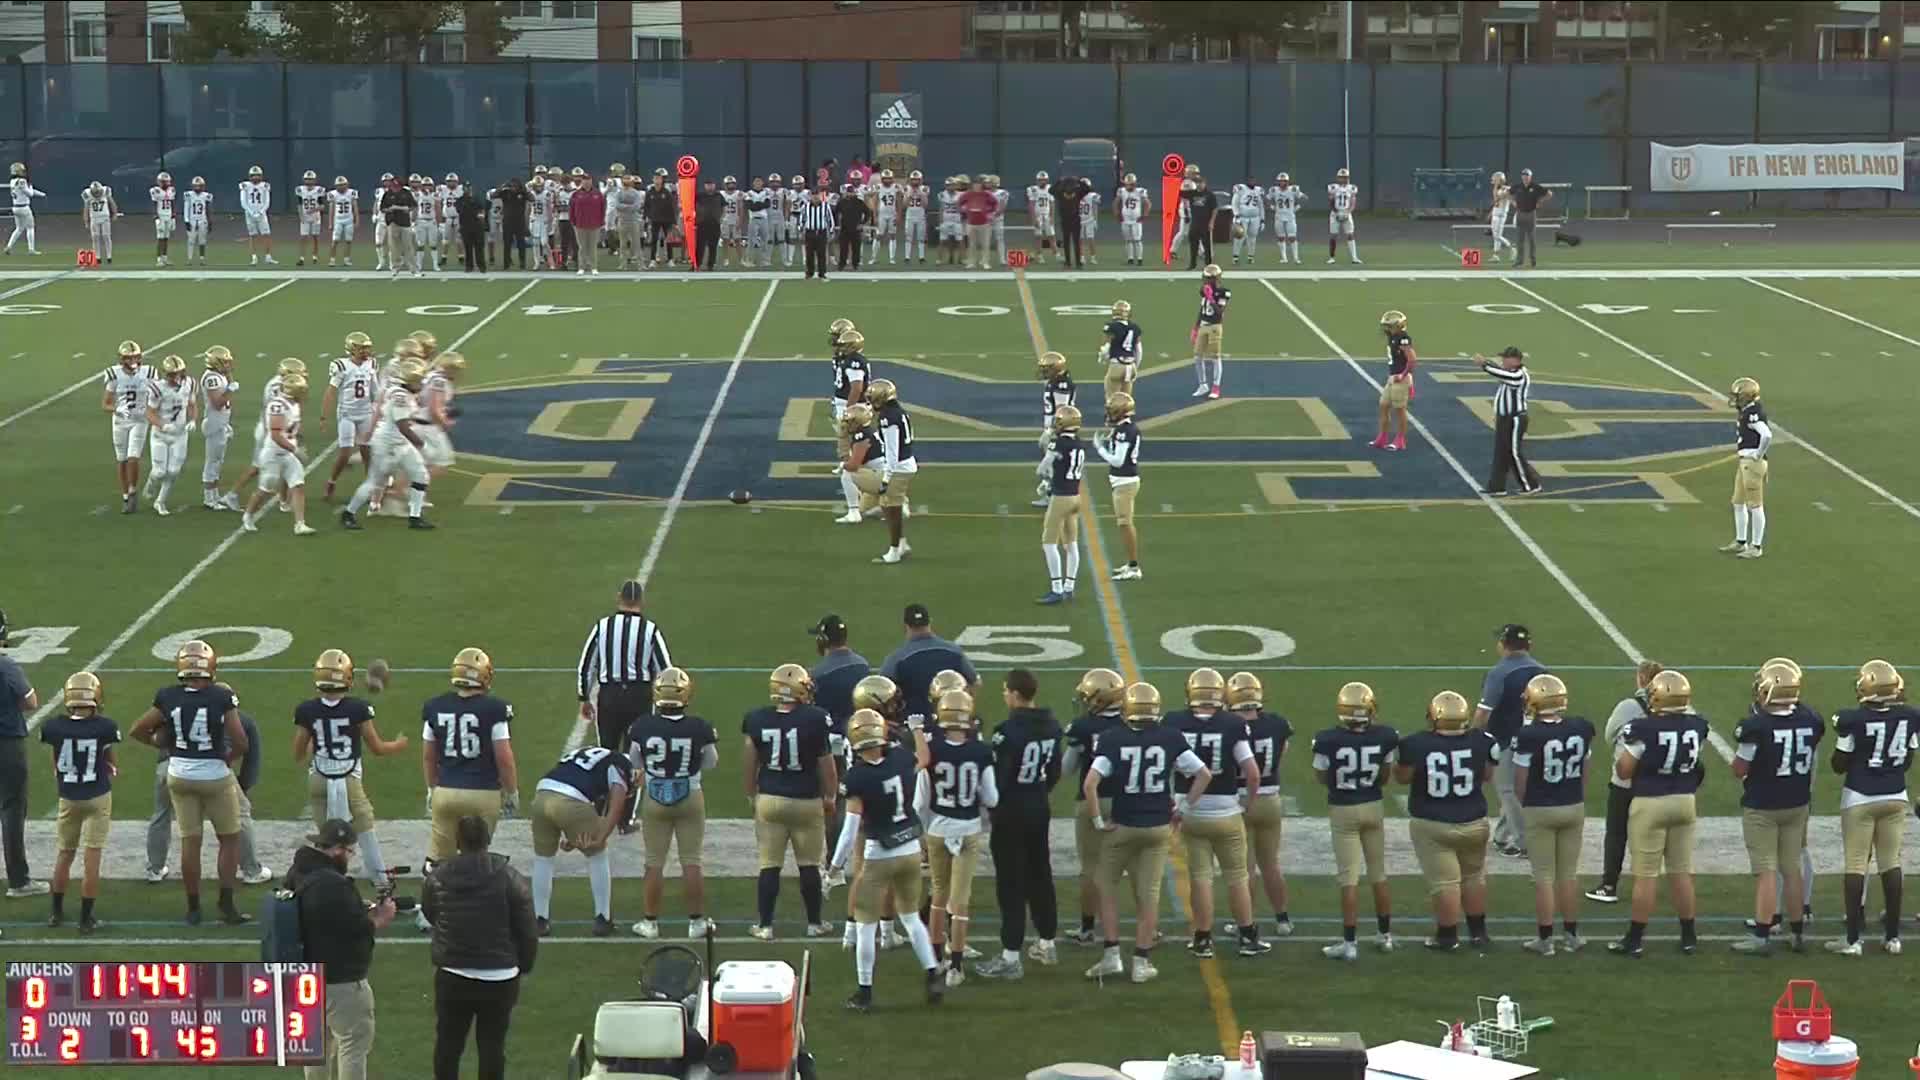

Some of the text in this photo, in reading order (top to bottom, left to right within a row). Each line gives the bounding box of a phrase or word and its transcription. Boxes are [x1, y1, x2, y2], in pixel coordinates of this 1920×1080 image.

[876, 117, 918, 128] adidas
[1729, 154, 1898, 177] IFA NEW ENGLAND
[1009, 251, 1024, 266] 50
[1464, 250, 1479, 264] 40
[1122, 330, 1133, 351] 4
[126, 391, 136, 409] 2
[208, 379, 218, 388] 21
[354, 380, 364, 399] 6
[170, 405, 182, 421] 7
[170, 707, 213, 750] 14
[312, 718, 352, 760] 15
[437, 713, 480, 758] 76
[761, 728, 802, 771] 71
[1866, 720, 1908, 768] 74
[57, 739, 97, 783] 47
[646, 736, 692, 777] 27
[1017, 739, 1056, 784] 87
[1120, 746, 1165, 794] 72
[1336, 746, 1381, 790] 25
[1426, 749, 1474, 798] 65
[1543, 735, 1584, 784] 62
[1658, 730, 1699, 774] 73
[1773, 727, 1813, 777] 75
[882, 775, 908, 822] 7
[935, 761, 979, 808] 20
[1796, 1020, 1811, 1035] G
